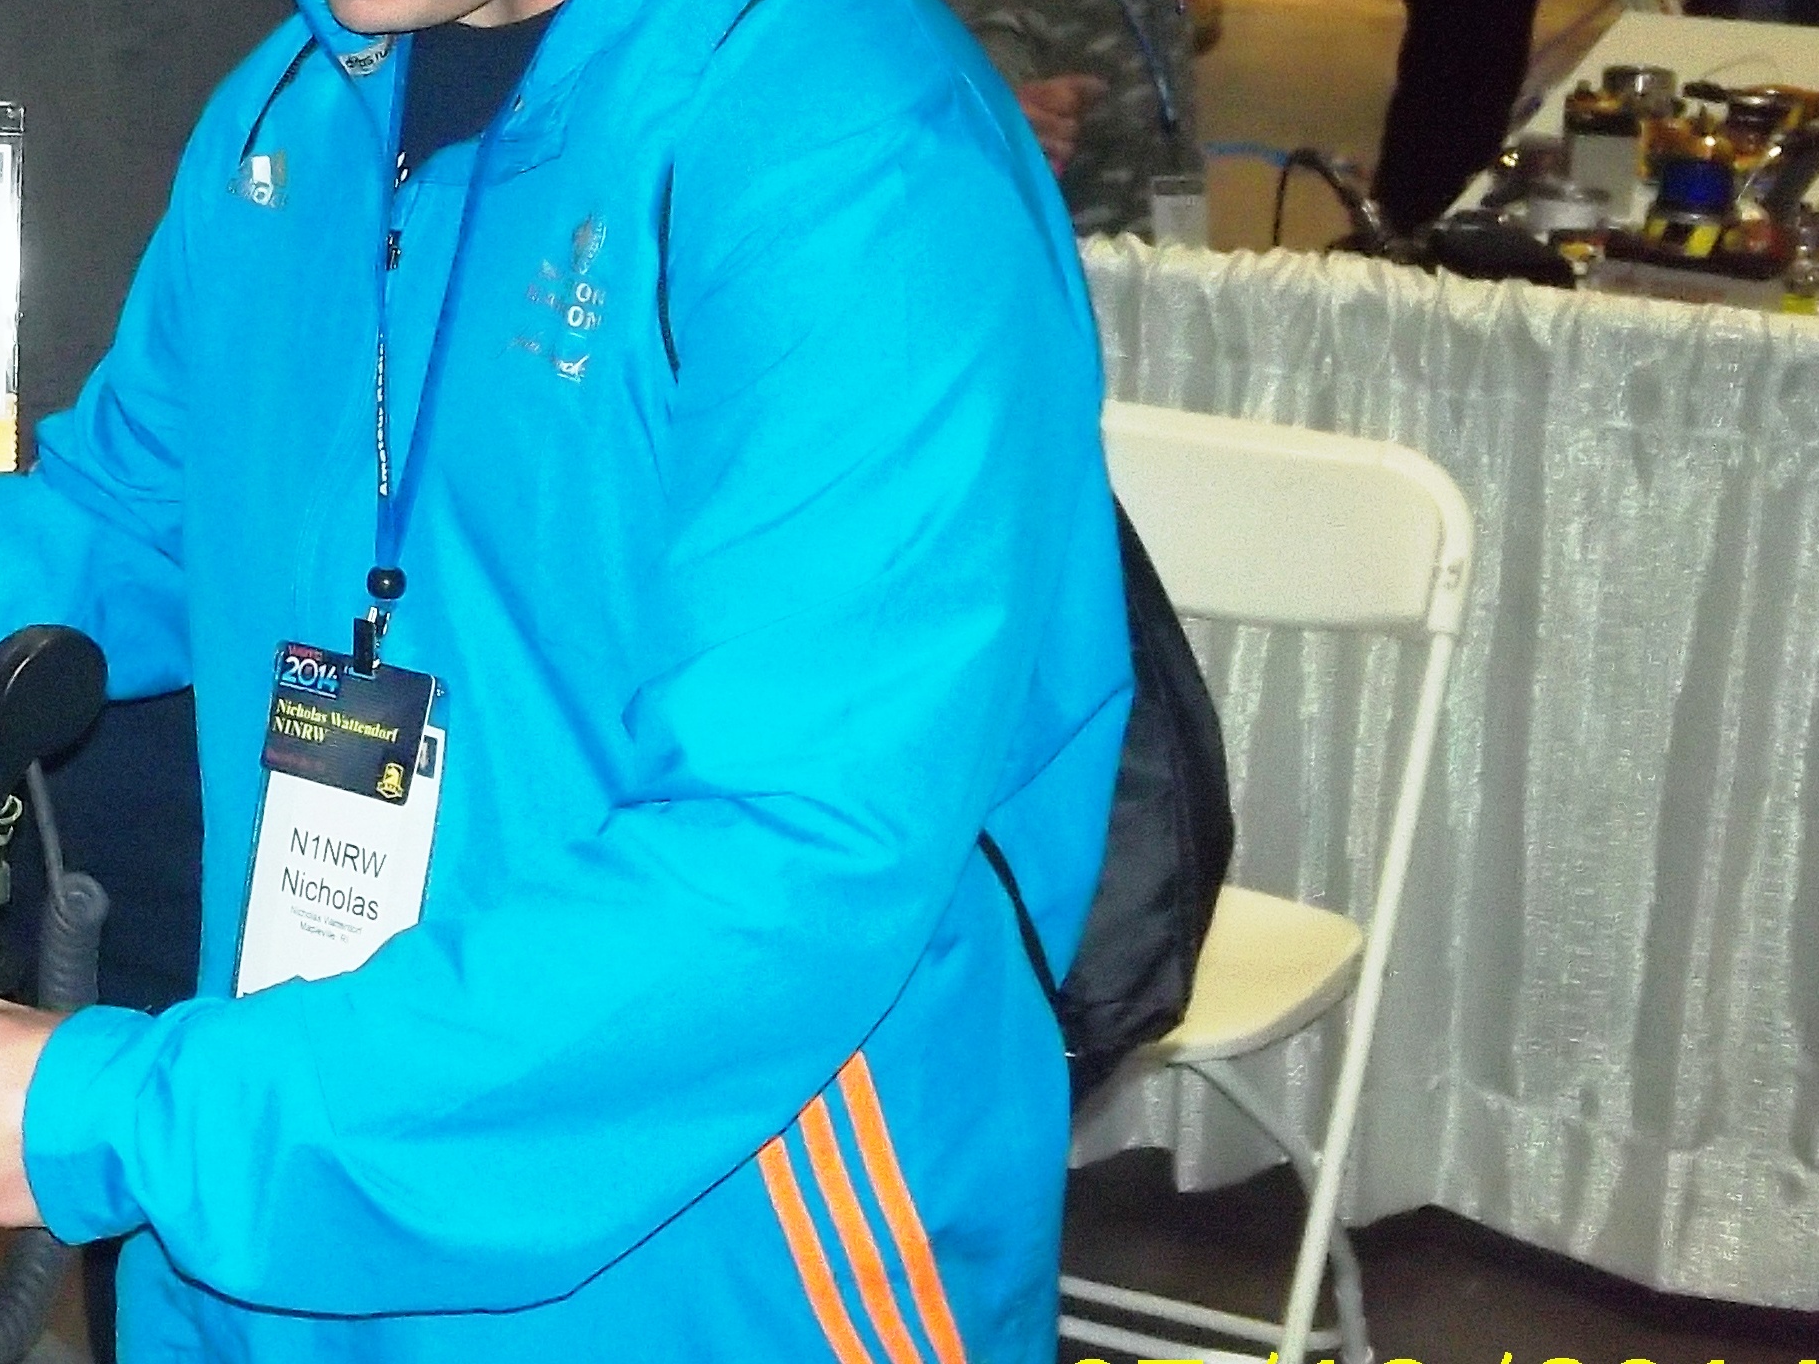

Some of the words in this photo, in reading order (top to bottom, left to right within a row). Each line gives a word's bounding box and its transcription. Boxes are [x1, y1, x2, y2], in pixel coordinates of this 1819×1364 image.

[276, 698, 328, 723] Nicholas
[330, 711, 400, 743] Wattendorf
[290, 827, 387, 878] N1NRW
[281, 866, 379, 921] Nicholas
